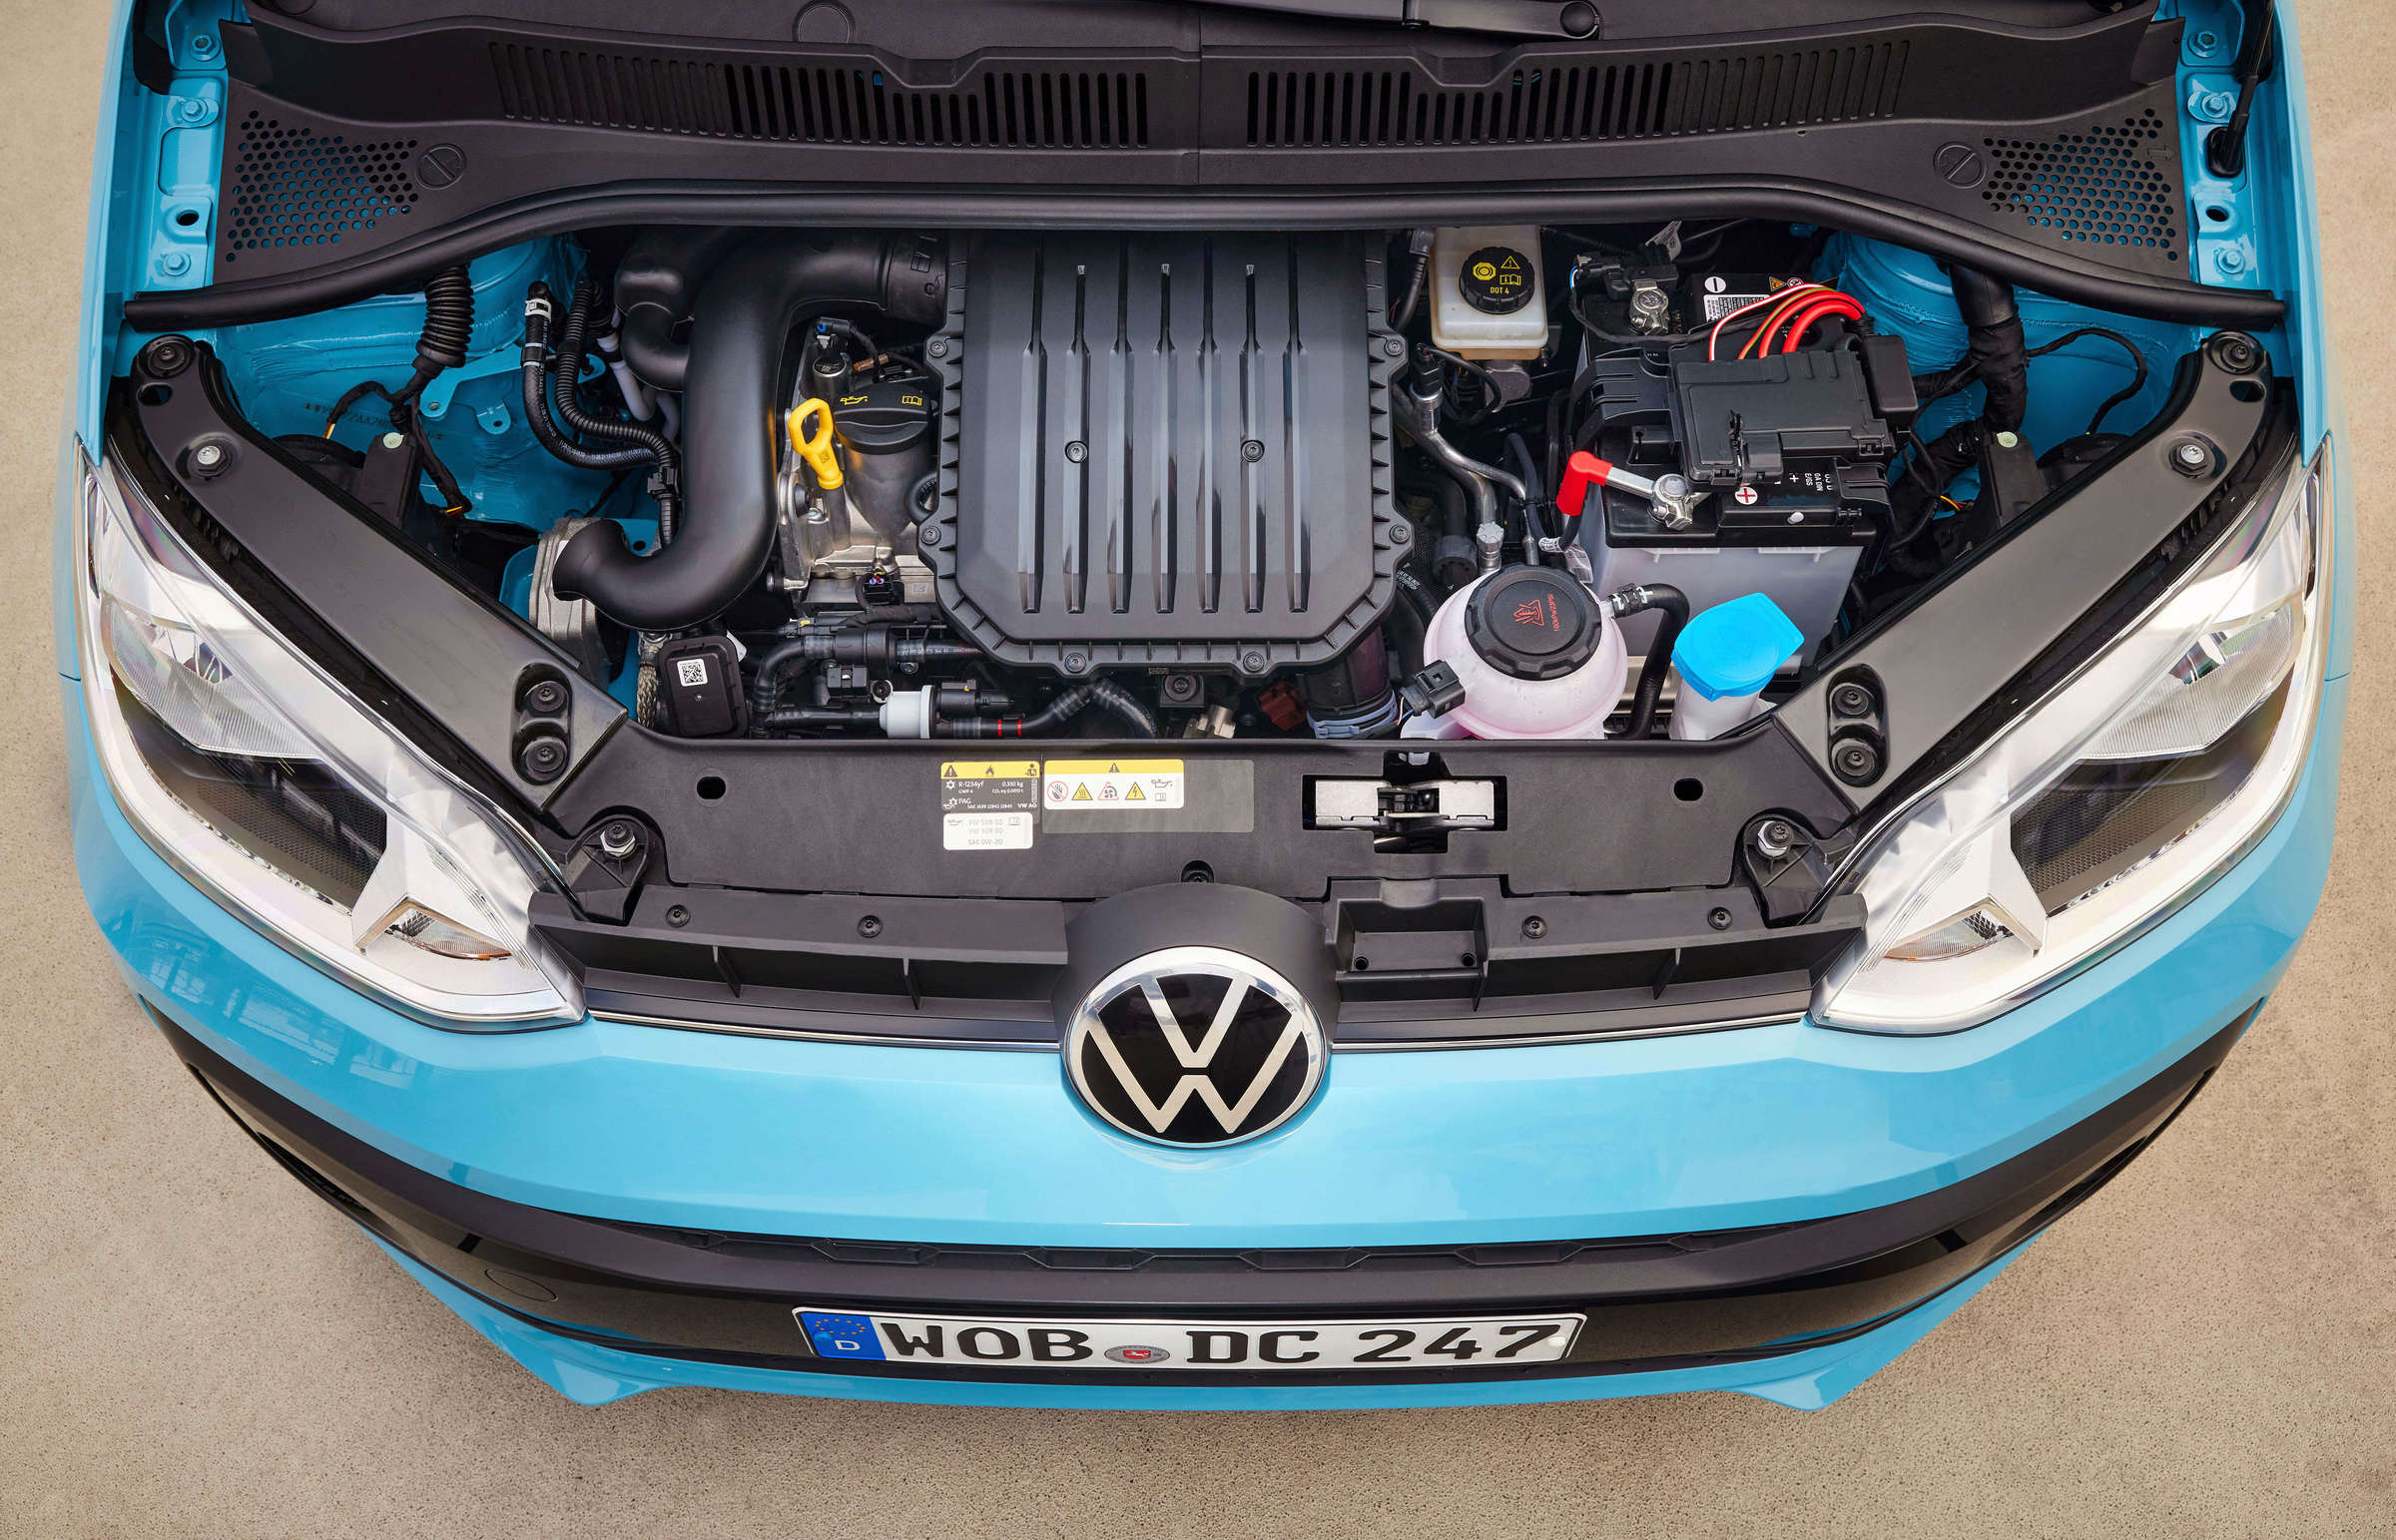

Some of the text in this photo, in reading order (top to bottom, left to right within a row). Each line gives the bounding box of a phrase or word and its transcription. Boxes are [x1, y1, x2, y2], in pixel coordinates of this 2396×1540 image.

[1078, 968, 1311, 1135] VW
[837, 1322, 1560, 1363] D WOB DC 247
